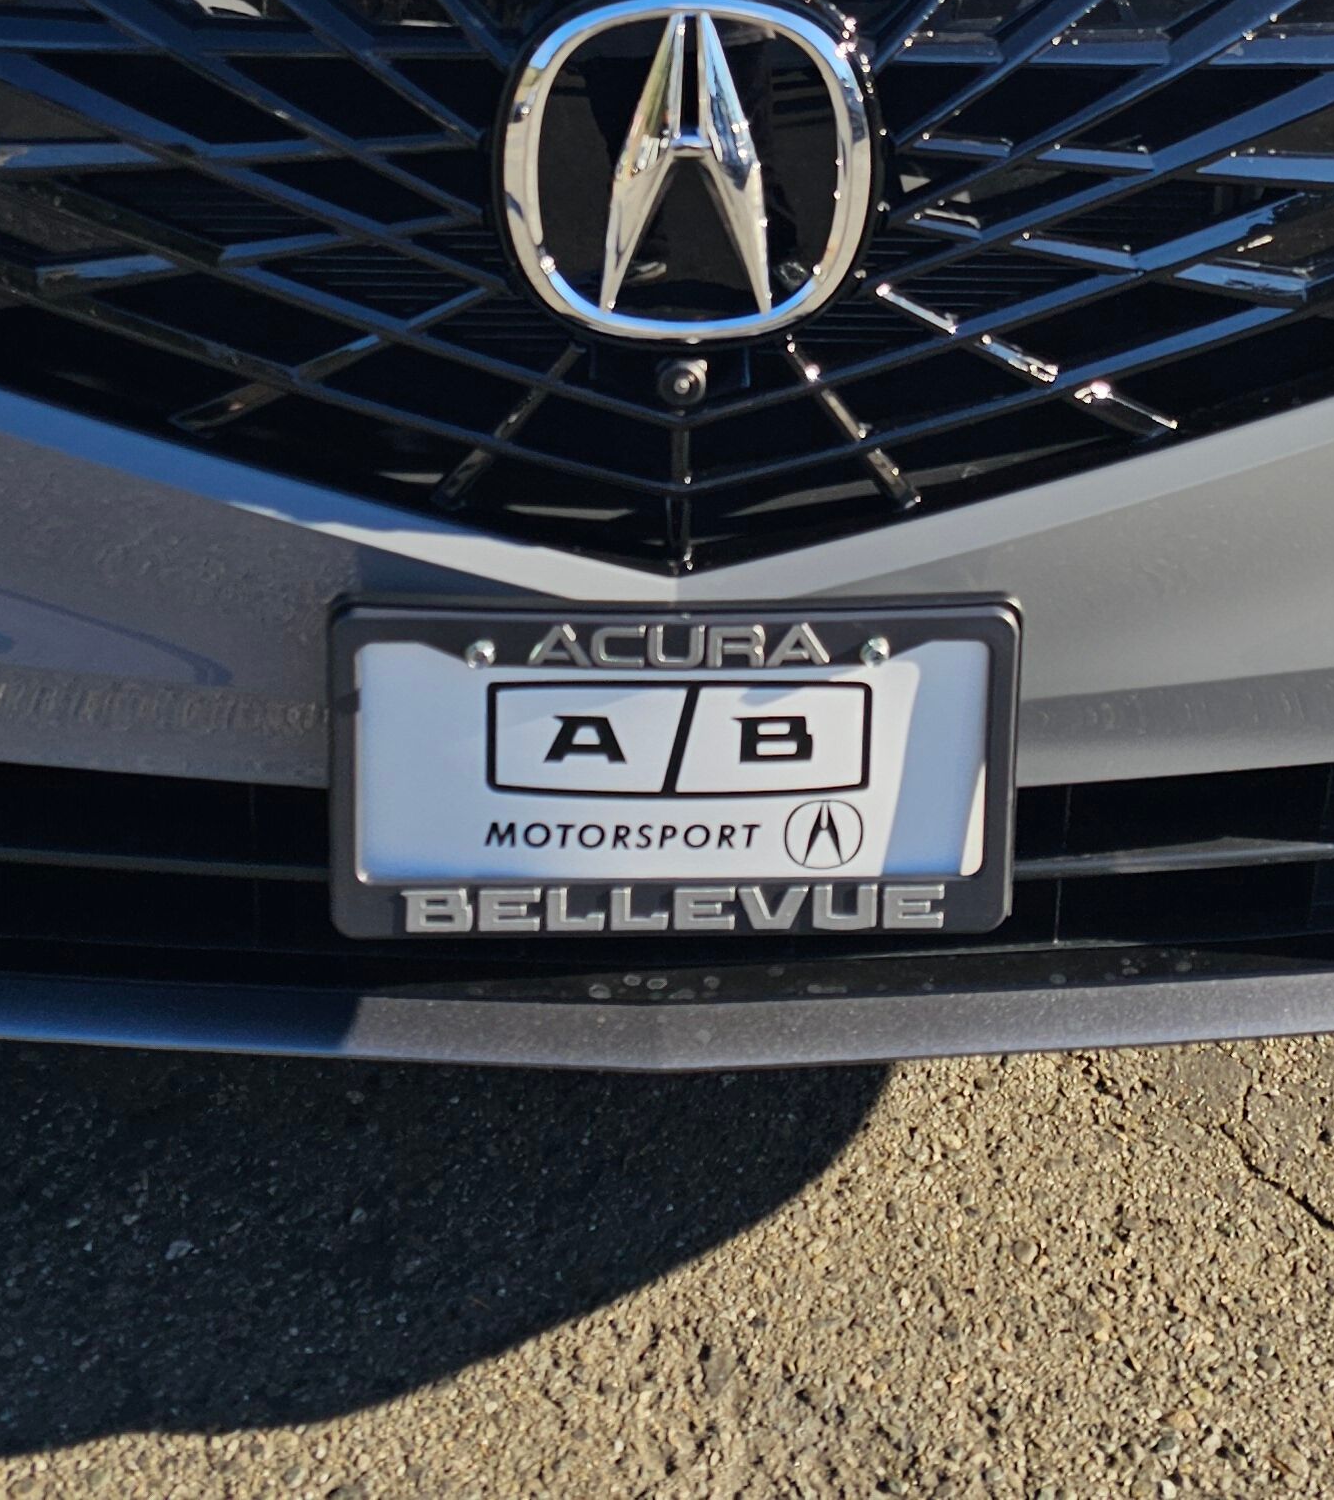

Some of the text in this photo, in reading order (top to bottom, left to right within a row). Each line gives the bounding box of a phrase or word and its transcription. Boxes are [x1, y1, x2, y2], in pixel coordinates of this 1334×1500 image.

[528, 622, 830, 668] ACURA
[544, 715, 813, 763] A B
[485, 822, 761, 849] MOTORSPORT
[401, 885, 945, 933] BELLEVUE
